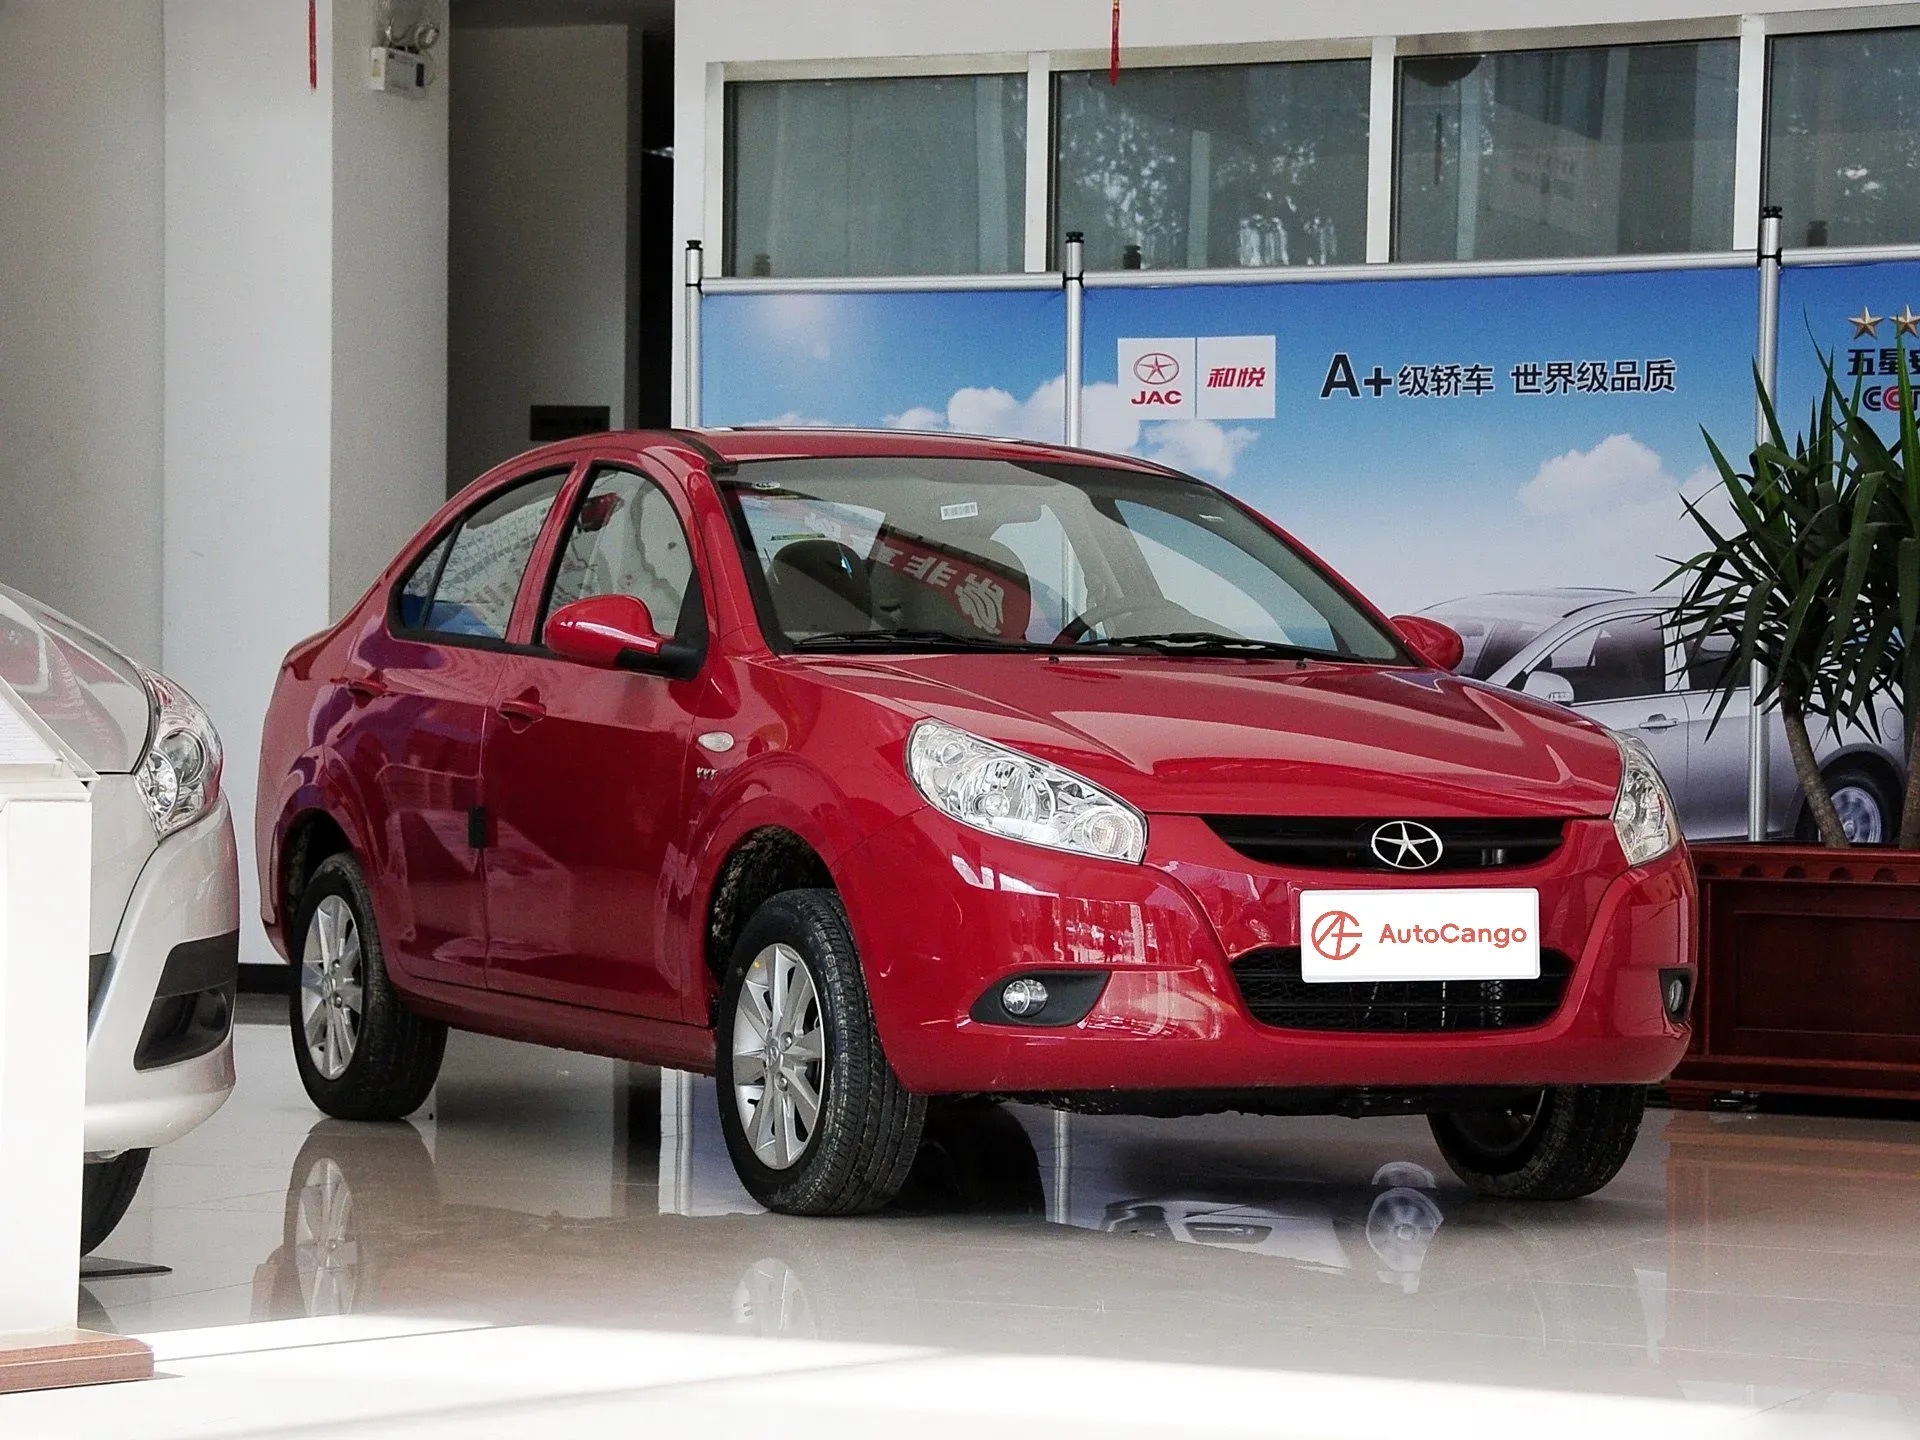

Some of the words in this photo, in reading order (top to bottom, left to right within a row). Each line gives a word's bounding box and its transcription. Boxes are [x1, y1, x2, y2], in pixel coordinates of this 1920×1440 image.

[1206, 367, 1266, 388] 和悦
[1511, 358, 1676, 395] 世界级品质
[1131, 390, 1182, 405] JAC
